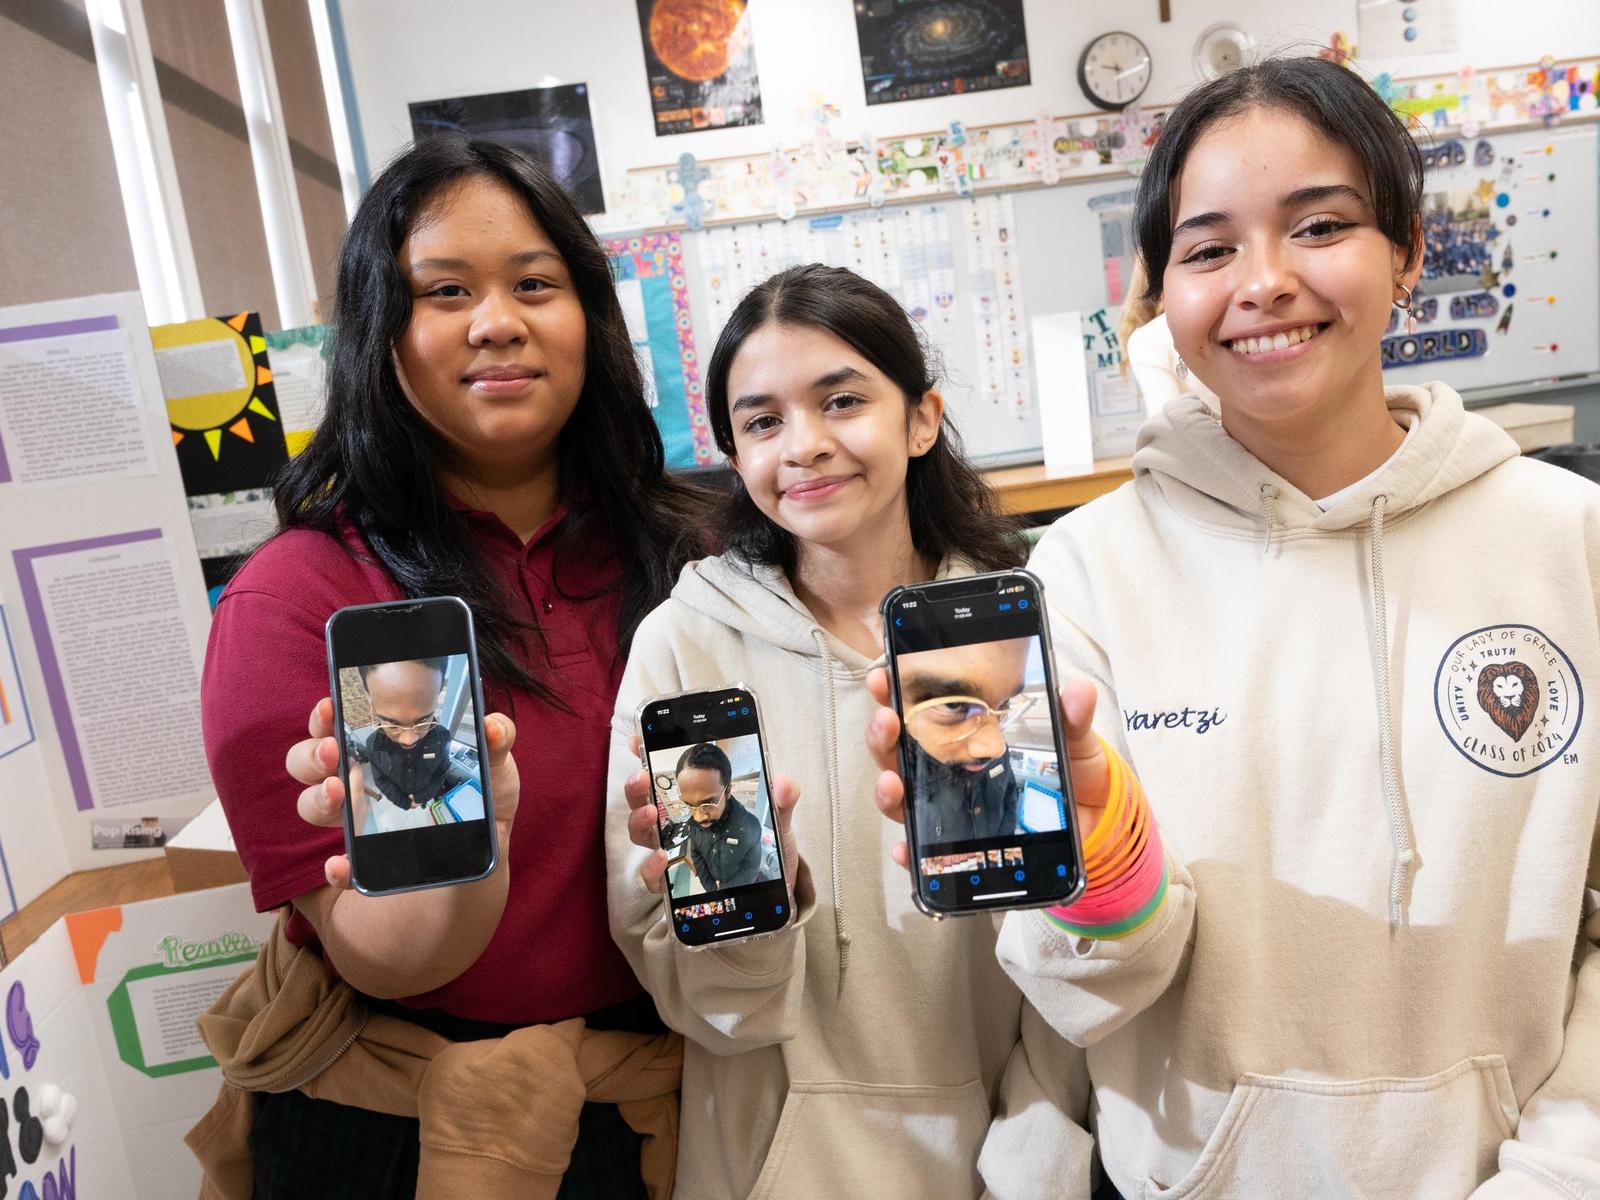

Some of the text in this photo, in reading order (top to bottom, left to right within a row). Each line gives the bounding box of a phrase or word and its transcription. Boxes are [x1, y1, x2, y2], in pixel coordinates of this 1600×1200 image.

[1451, 631, 1557, 673] OUR LADY OF GRACE
[1480, 647, 1516, 659] TRUTH
[1454, 685, 1469, 721] UNITY
[1547, 680, 1559, 712] LOVE
[1123, 707, 1228, 735] Yaretzi
[1463, 732, 1563, 762] CLASS OF 2024
[1563, 753, 1579, 765] EM
[94, 824, 162, 839] Pop Rising
[159, 933, 256, 964] Results
